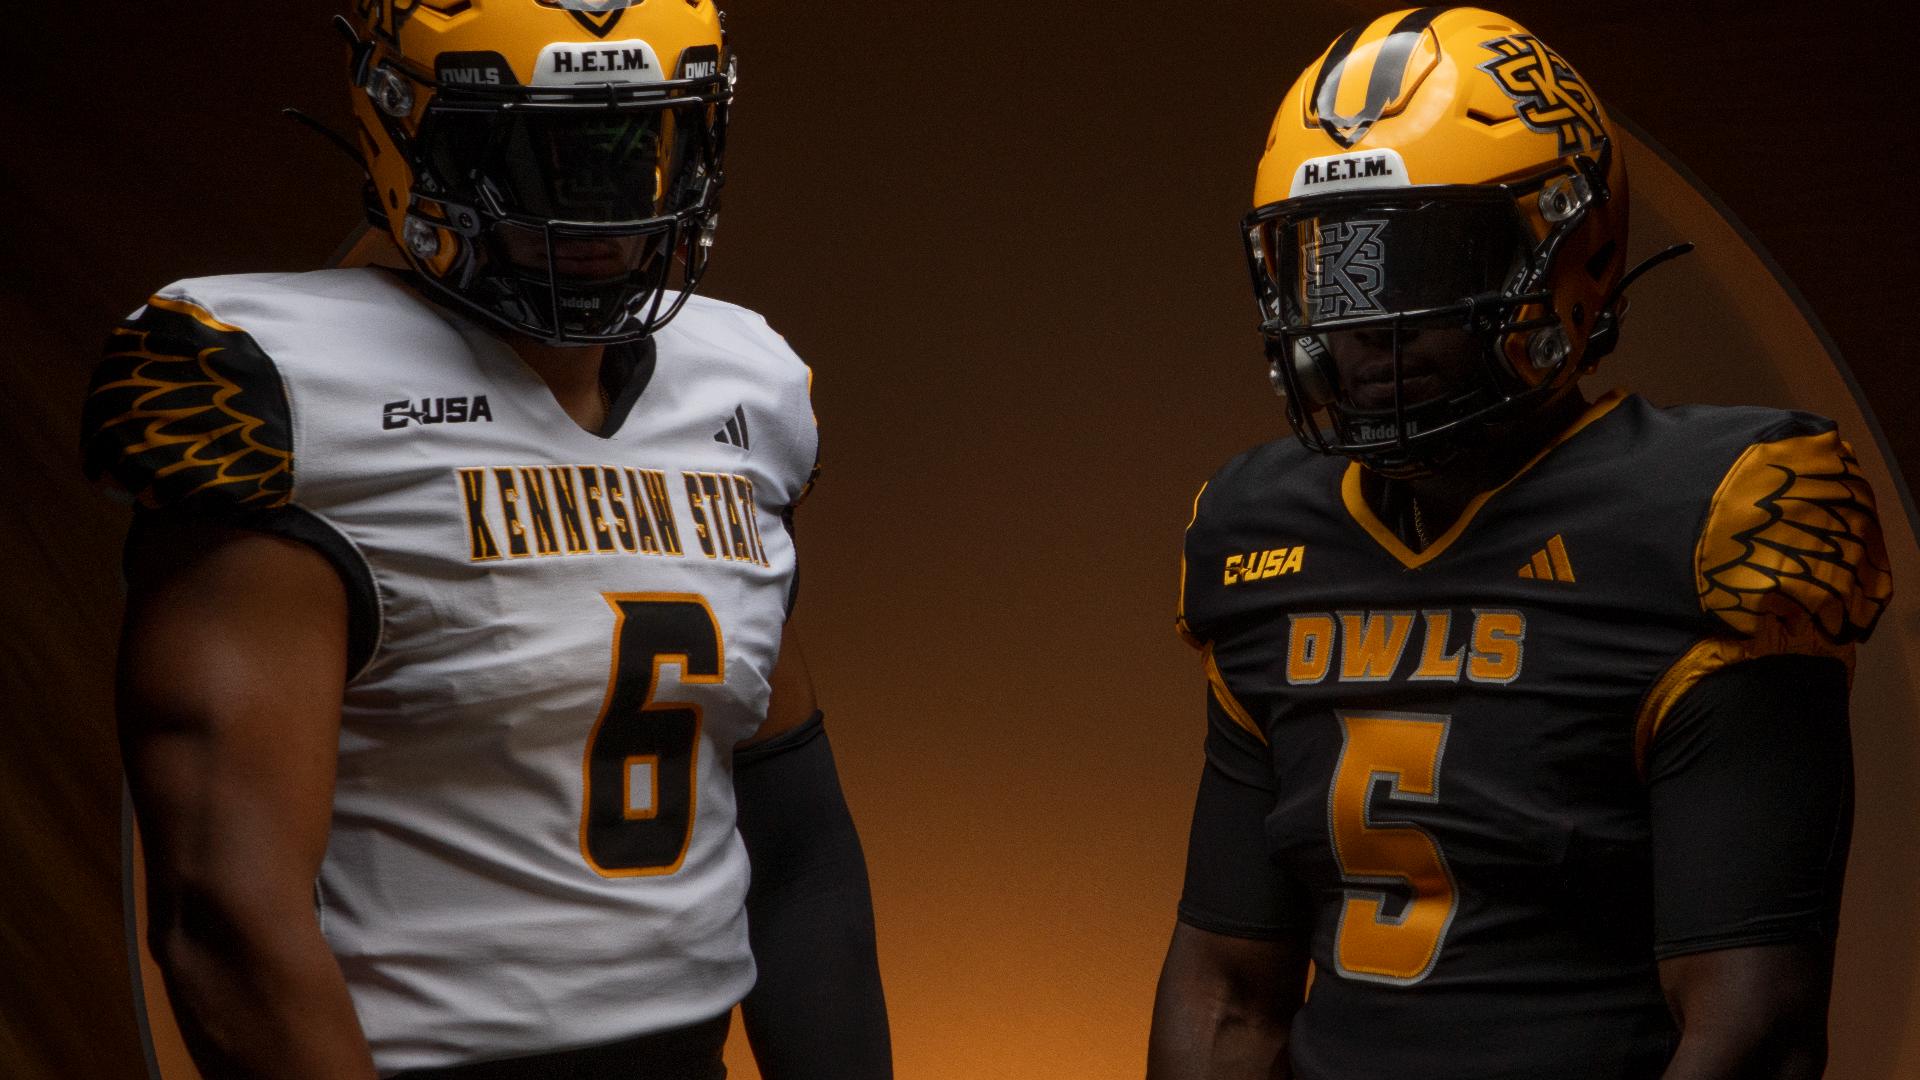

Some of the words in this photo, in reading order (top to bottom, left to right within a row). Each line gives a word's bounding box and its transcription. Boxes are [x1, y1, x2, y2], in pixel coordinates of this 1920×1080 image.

[553, 49, 650, 73] H.E.T.M.
[1303, 156, 1393, 185] H.E.T.M.
[1359, 421, 1418, 440] Riddll
[456, 465, 684, 561] KENNESAW
[1285, 608, 1528, 686] OWLS
[579, 592, 725, 878] 6
[1326, 708, 1460, 987] 5
